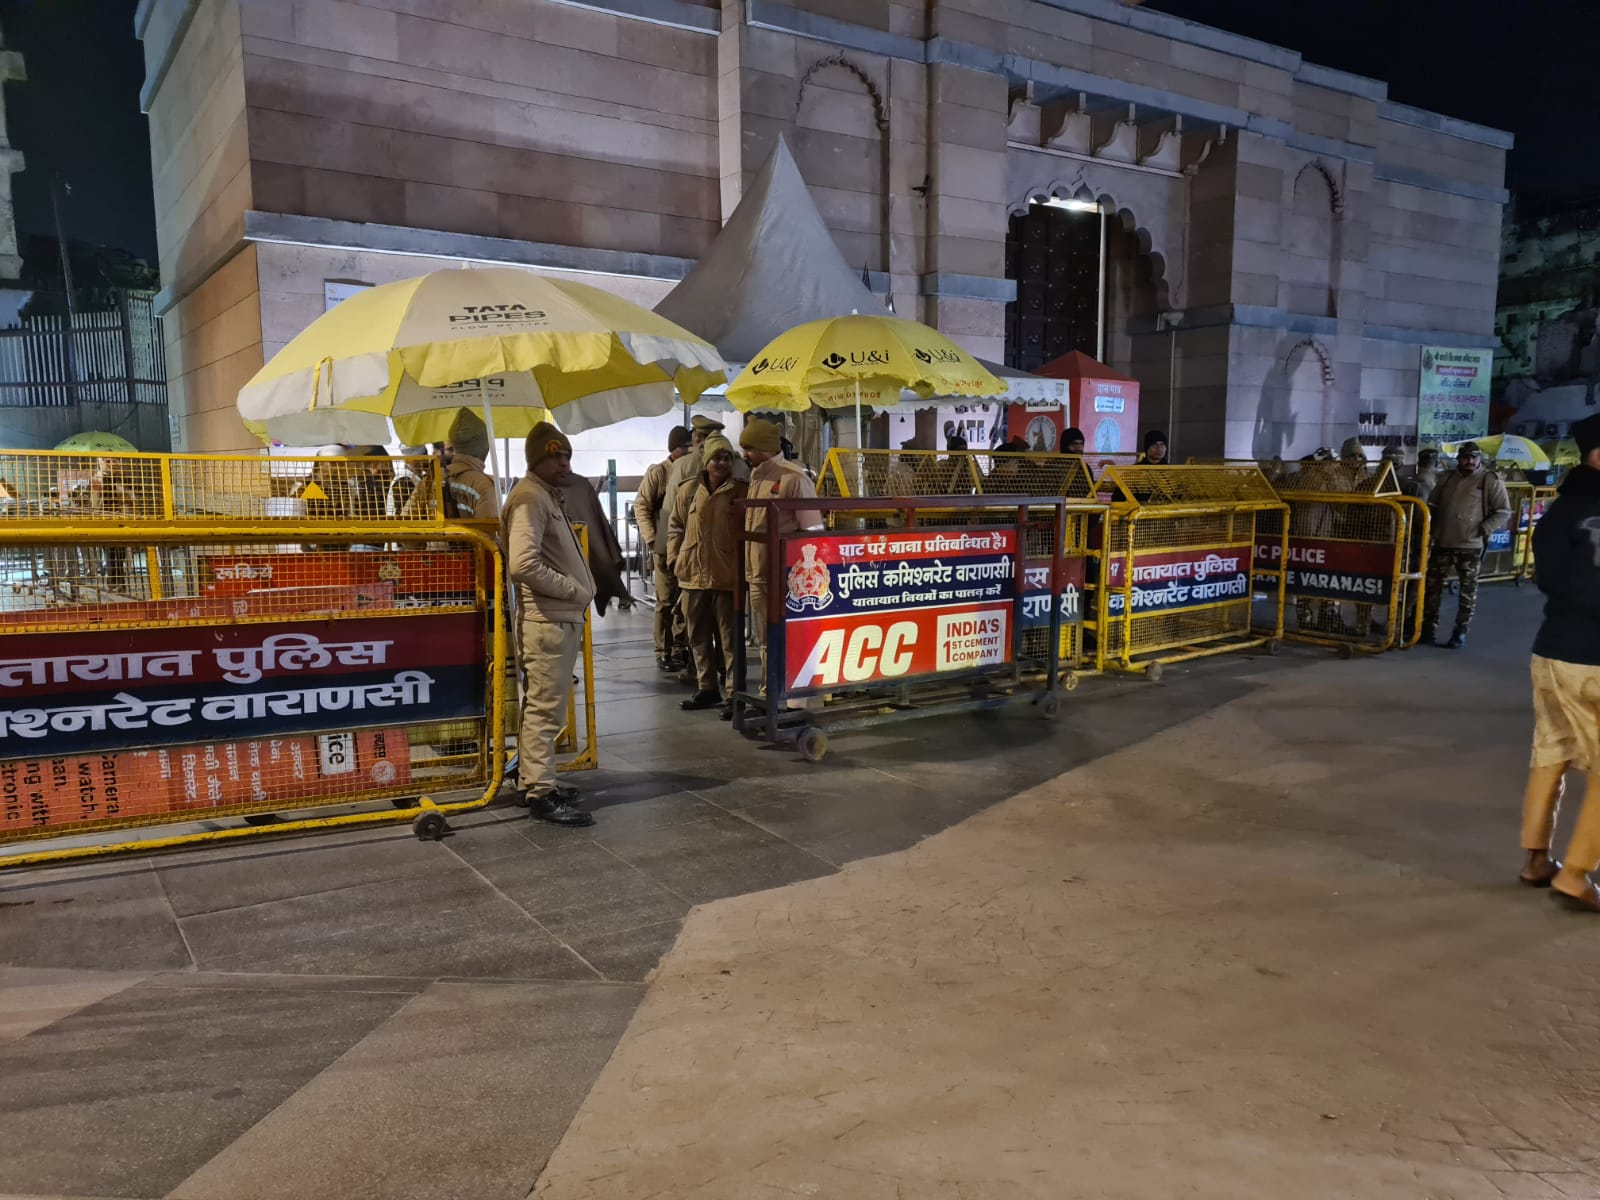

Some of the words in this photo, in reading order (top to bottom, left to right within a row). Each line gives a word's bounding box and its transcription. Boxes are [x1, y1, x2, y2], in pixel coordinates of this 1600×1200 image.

[449, 311, 546, 322] PIPES
[463, 304, 527, 314] TATA
[851, 349, 889, 364] U&i
[839, 544, 865, 556] घाट
[889, 541, 922, 554] जाना
[925, 534, 991, 553] प्रतिबन्धित
[1194, 554, 1240, 581] पुलिस
[838, 564, 879, 598] पुलिस
[882, 560, 953, 587] कमिश्नरेट
[1192, 573, 1248, 600] वाराणसी
[1300, 572, 1383, 595] VARANASI
[852, 595, 900, 607] यातायात
[939, 590, 954, 600] का
[947, 618, 1000, 638] INDIA'S
[964, 637, 999, 648] CEMENT
[212, 633, 394, 684] पुलिस
[791, 621, 918, 688] ACC
[952, 648, 999, 662] COMPANY
[201, 670, 435, 721] वाराणसी
